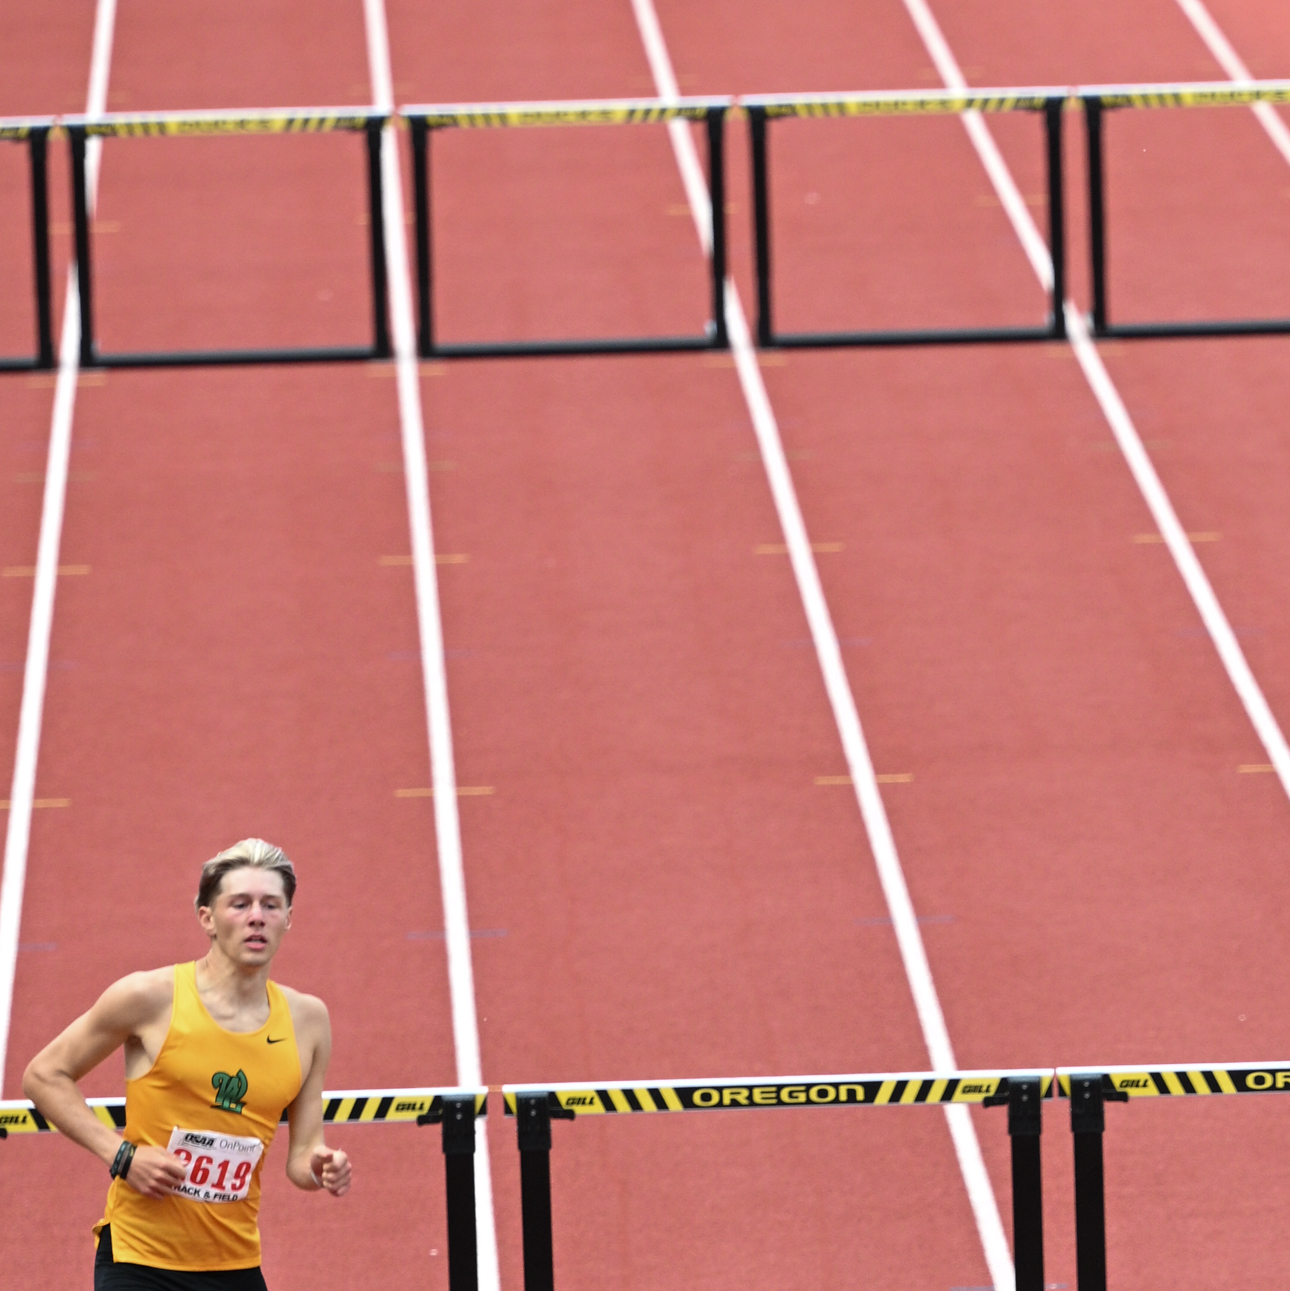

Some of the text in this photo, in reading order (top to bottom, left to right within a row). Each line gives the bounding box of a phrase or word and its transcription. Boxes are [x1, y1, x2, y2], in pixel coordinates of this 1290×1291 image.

[1118, 1078, 1151, 1090] GILL
[565, 1083, 994, 1107] GILL OREGON GILL
[395, 1100, 426, 1113] GILL
[219, 1138, 256, 1152] OnPoint
[203, 1190, 210, 1199] &
[213, 1192, 239, 1202] FIELD
